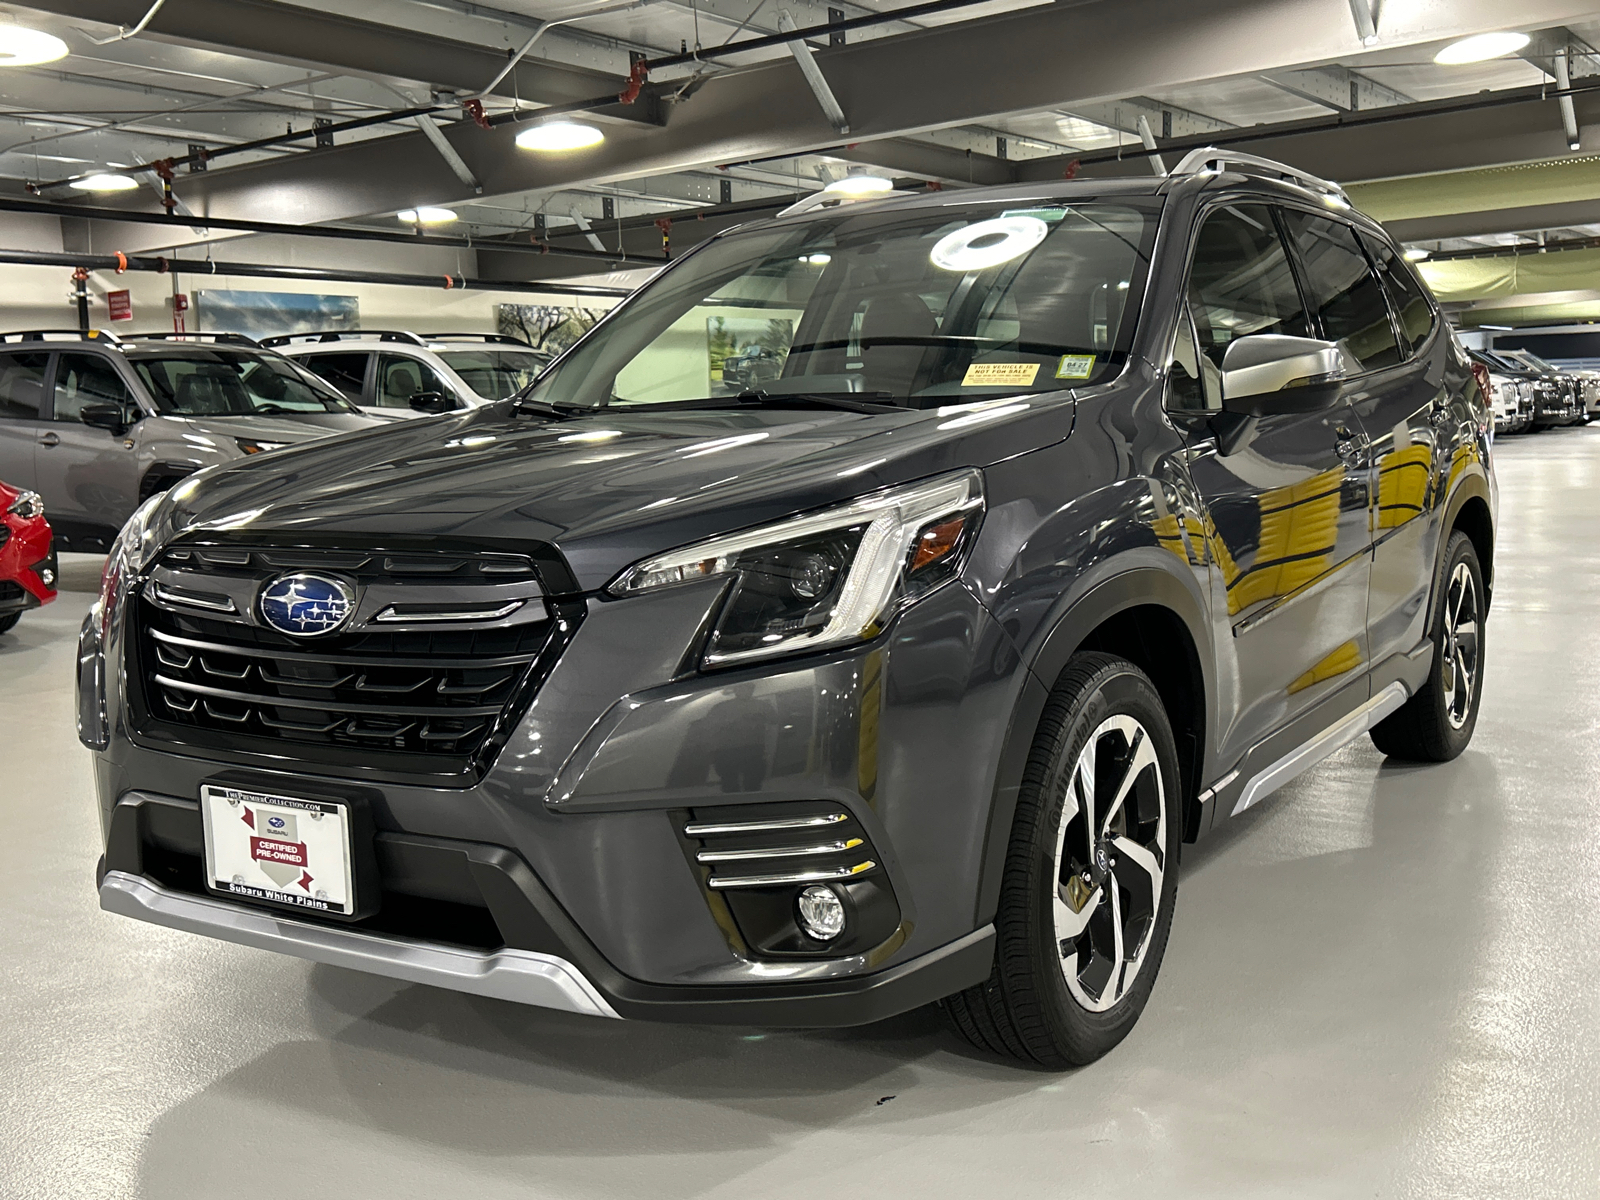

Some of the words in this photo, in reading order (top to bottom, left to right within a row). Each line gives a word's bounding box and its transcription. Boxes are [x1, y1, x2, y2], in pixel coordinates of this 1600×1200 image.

[267, 828, 288, 836] SUBARU
[259, 841, 298, 854] CERTIFIED
[256, 848, 302, 862] PRE-OWNED
[229, 883, 263, 897] Subaru
[265, 890, 294, 904] White
[296, 896, 328, 910] Plains
